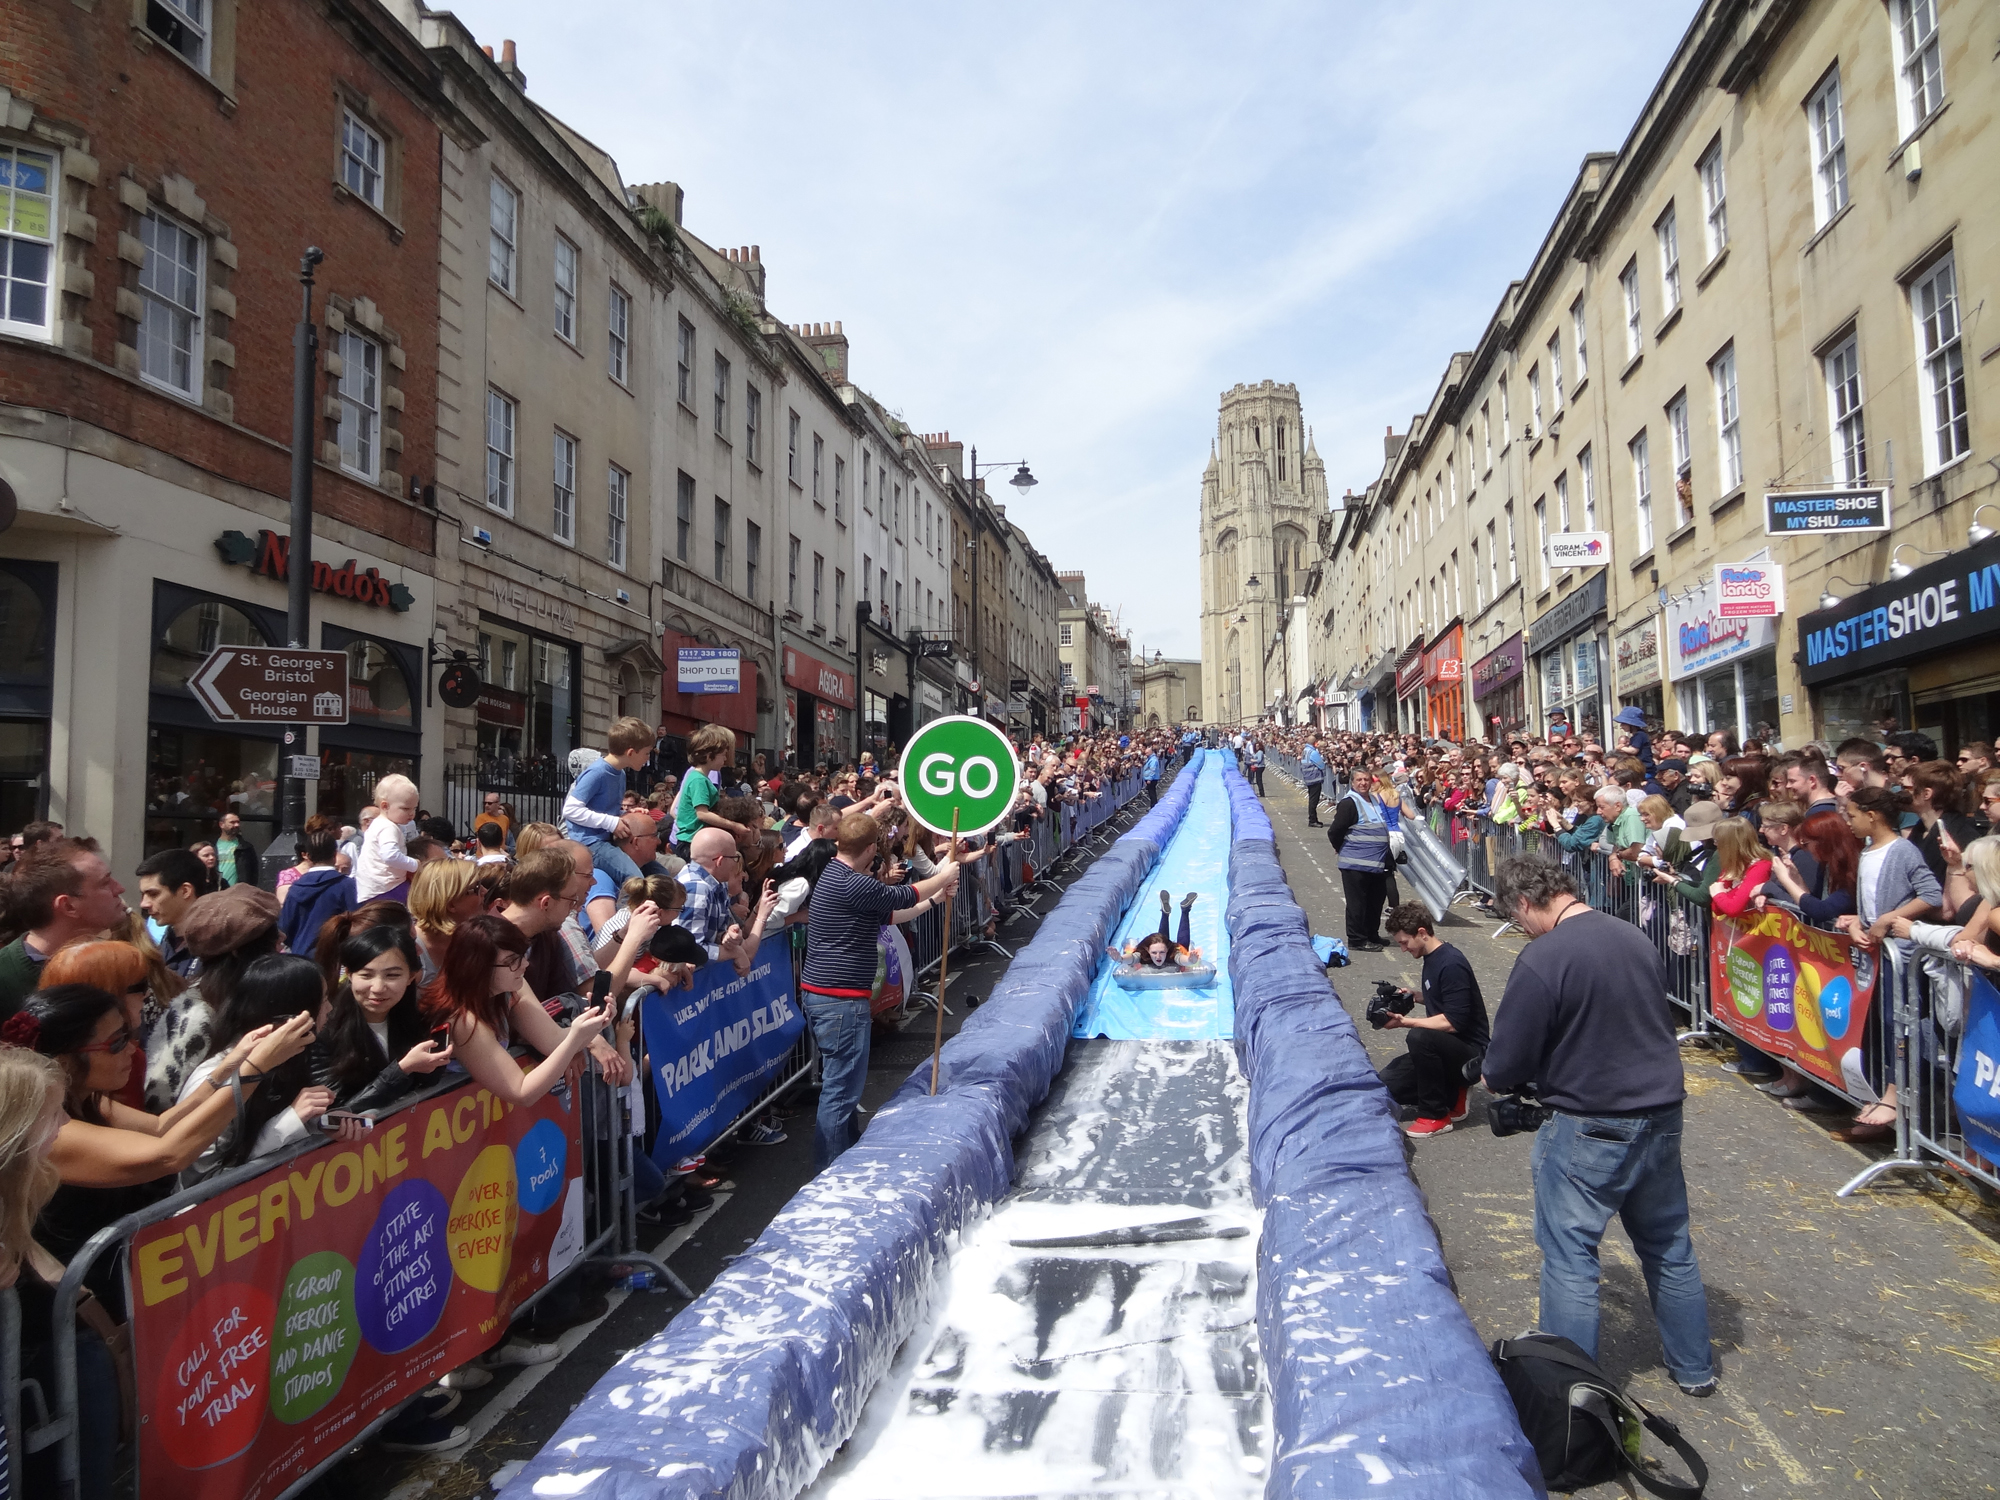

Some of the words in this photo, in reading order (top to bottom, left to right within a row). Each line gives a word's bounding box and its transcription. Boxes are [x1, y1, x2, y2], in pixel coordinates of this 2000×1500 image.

[1774, 496, 1878, 514] MASTERSHOE
[1786, 515, 1870, 529] MYSHU.co.uk
[258, 529, 391, 607] Nndo's
[492, 581, 576, 633] MELUHA
[1806, 578, 1959, 667] MASTERSHOE
[240, 653, 262, 667] St.
[268, 655, 334, 671] George's
[264, 669, 315, 683] Bristol
[679, 666, 704, 675] SHOP
[705, 667, 718, 675] TO
[720, 667, 737, 675] LET
[1440, 659, 1459, 675] £3
[239, 688, 308, 704] Georgian
[818, 668, 844, 700] AGORA
[250, 703, 298, 716] House
[919, 752, 999, 799] GO
[1861, 953, 1867, 970] 5
[1825, 1007, 1842, 1020] POOLS
[1832, 993, 1839, 1005] 7
[661, 1039, 715, 1099] PARK
[714, 1018, 751, 1063] AND
[752, 993, 795, 1041] SLIDE
[539, 1146, 547, 1164] 7
[529, 1157, 559, 1193] POOLS
[138, 1122, 409, 1307] EVERYONE
[422, 1078, 520, 1158] ACTI
[468, 1182, 503, 1204] OVER
[385, 1200, 423, 1244] STATE
[448, 1208, 502, 1235] EXERCISE
[385, 1238, 410, 1272] THE
[413, 1213, 435, 1251] ART
[458, 1234, 502, 1260] EVERY
[295, 1268, 342, 1301] GROUP
[383, 1249, 432, 1307] FITNESS
[285, 1300, 341, 1338] EXERCISE
[385, 1274, 437, 1332] CENTRES
[177, 1342, 210, 1387] CALL
[212, 1306, 248, 1346] FOR
[275, 1349, 298, 1377] AND
[303, 1328, 347, 1363] DANCE
[177, 1370, 219, 1426] YOUR
[218, 1326, 268, 1380] FREE
[284, 1362, 333, 1406] STUDIOS
[200, 1377, 256, 1427] TRIAL
[314, 1430, 329, 1444] 0117
